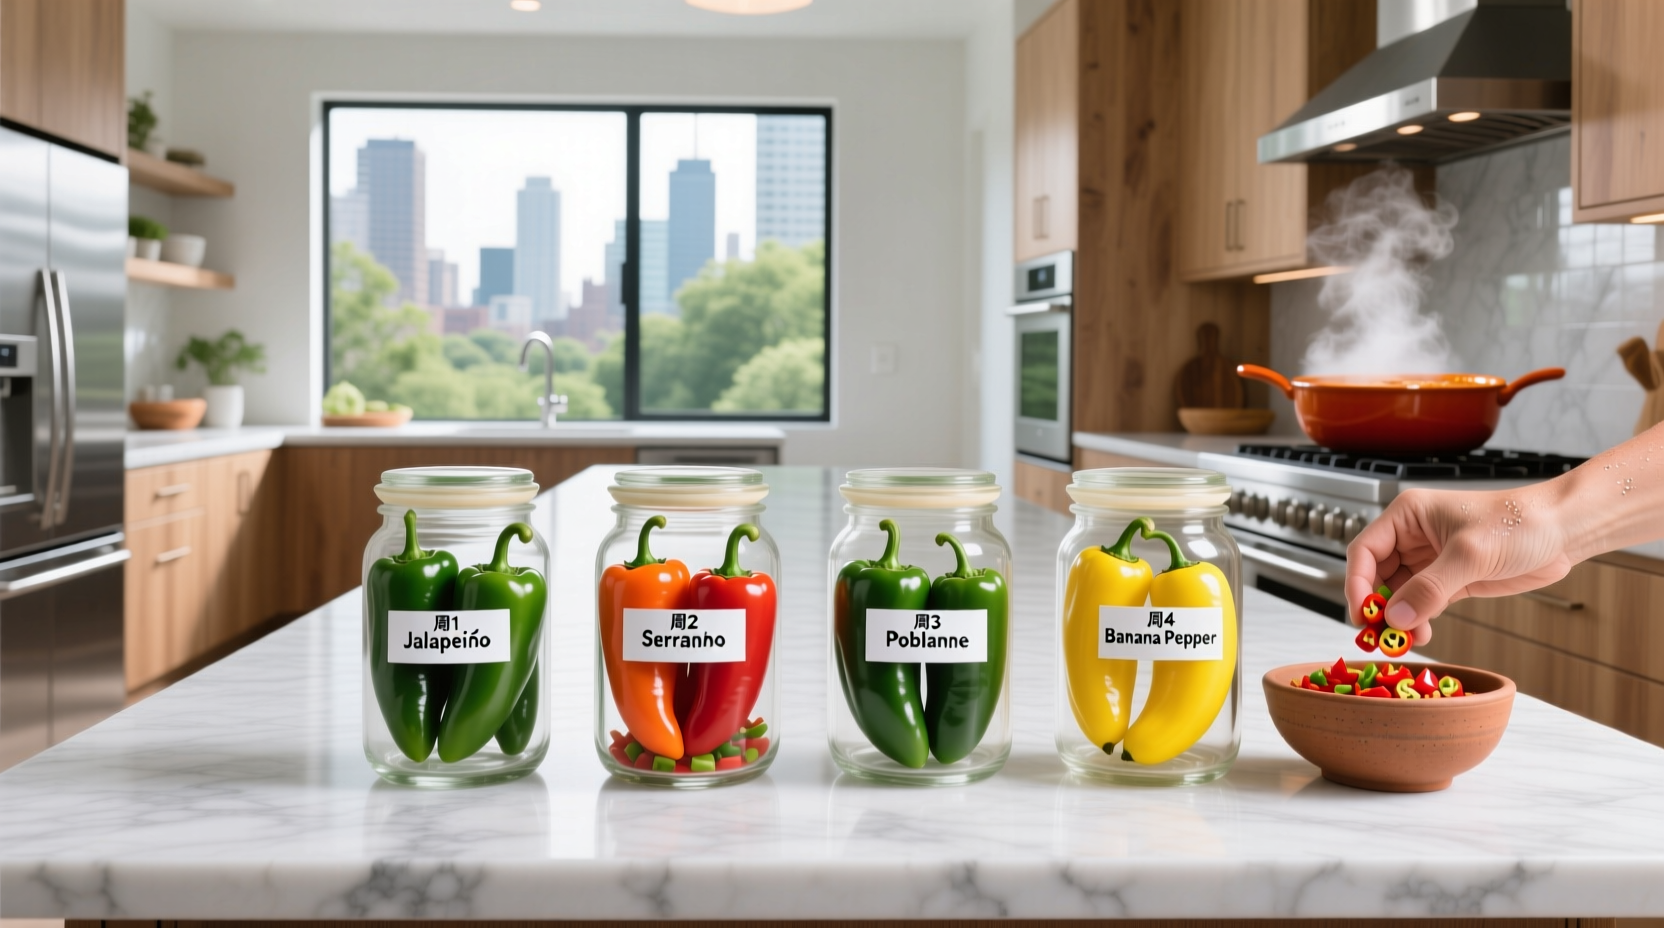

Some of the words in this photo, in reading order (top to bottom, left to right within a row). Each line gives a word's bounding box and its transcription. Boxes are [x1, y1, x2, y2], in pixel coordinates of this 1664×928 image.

[886, 630, 969, 649] Poblanne
[1105, 628, 1161, 645] Banana
[1164, 630, 1217, 649] Pepper
